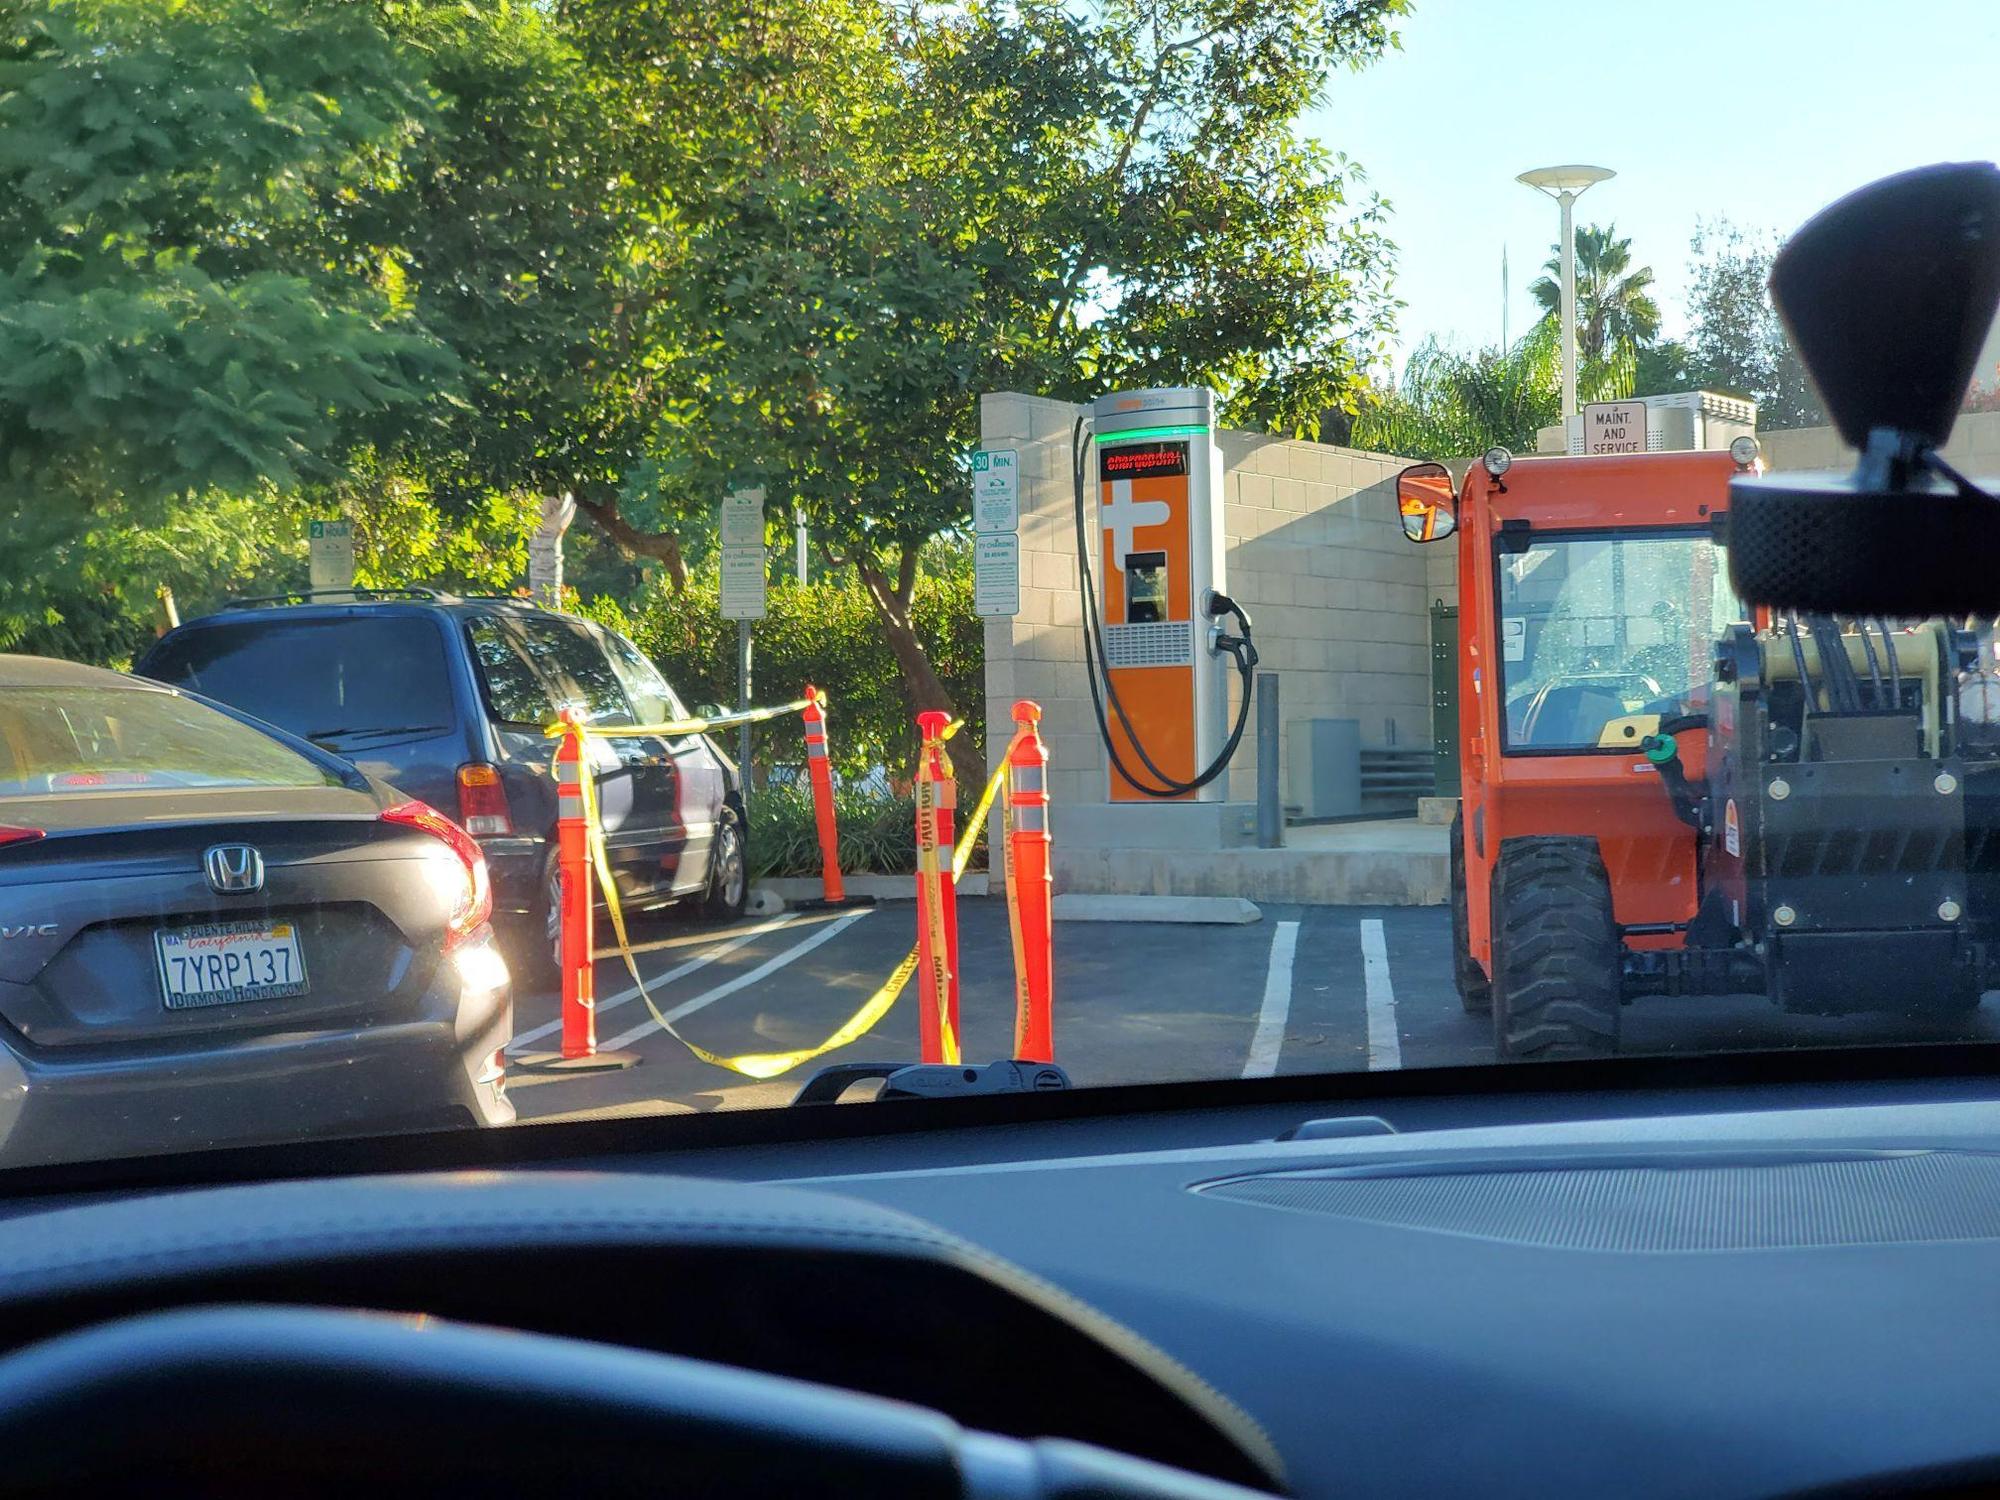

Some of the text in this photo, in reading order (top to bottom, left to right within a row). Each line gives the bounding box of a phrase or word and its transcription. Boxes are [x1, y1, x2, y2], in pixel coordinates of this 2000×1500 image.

[1596, 412, 1632, 425] MAINT.
[1603, 427, 1626, 440] AND
[1593, 442, 1639, 455] SERVICE
[975, 456, 988, 470] 30
[313, 523, 322, 537] 2
[921, 782, 933, 852] CAUTION
[191, 924, 232, 938] PUENTE
[171, 947, 290, 993] 7YRP137
